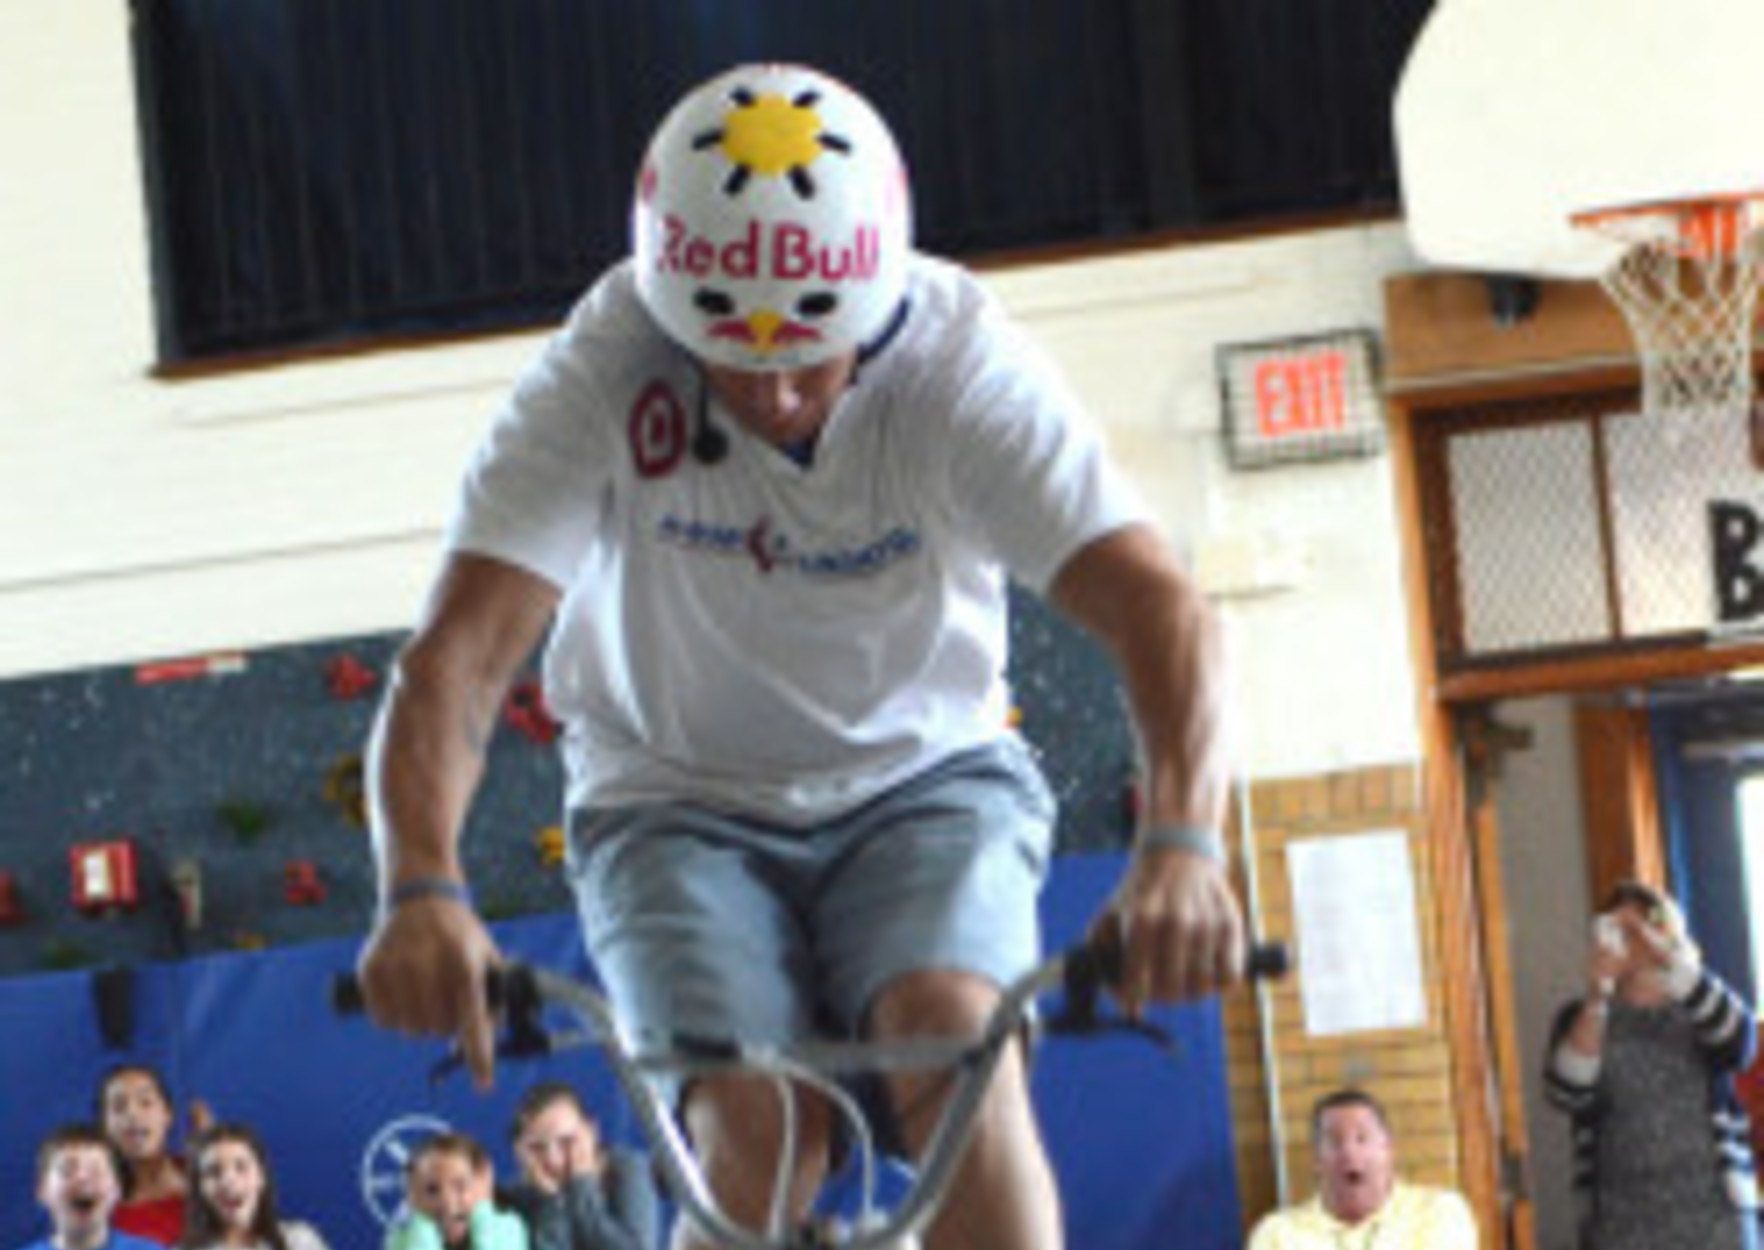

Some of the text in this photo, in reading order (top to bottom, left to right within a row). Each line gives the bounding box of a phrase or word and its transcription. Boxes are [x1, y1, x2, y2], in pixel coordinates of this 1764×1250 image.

[657, 210, 880, 282] Red Bull
[1254, 349, 1345, 437] EXIT
